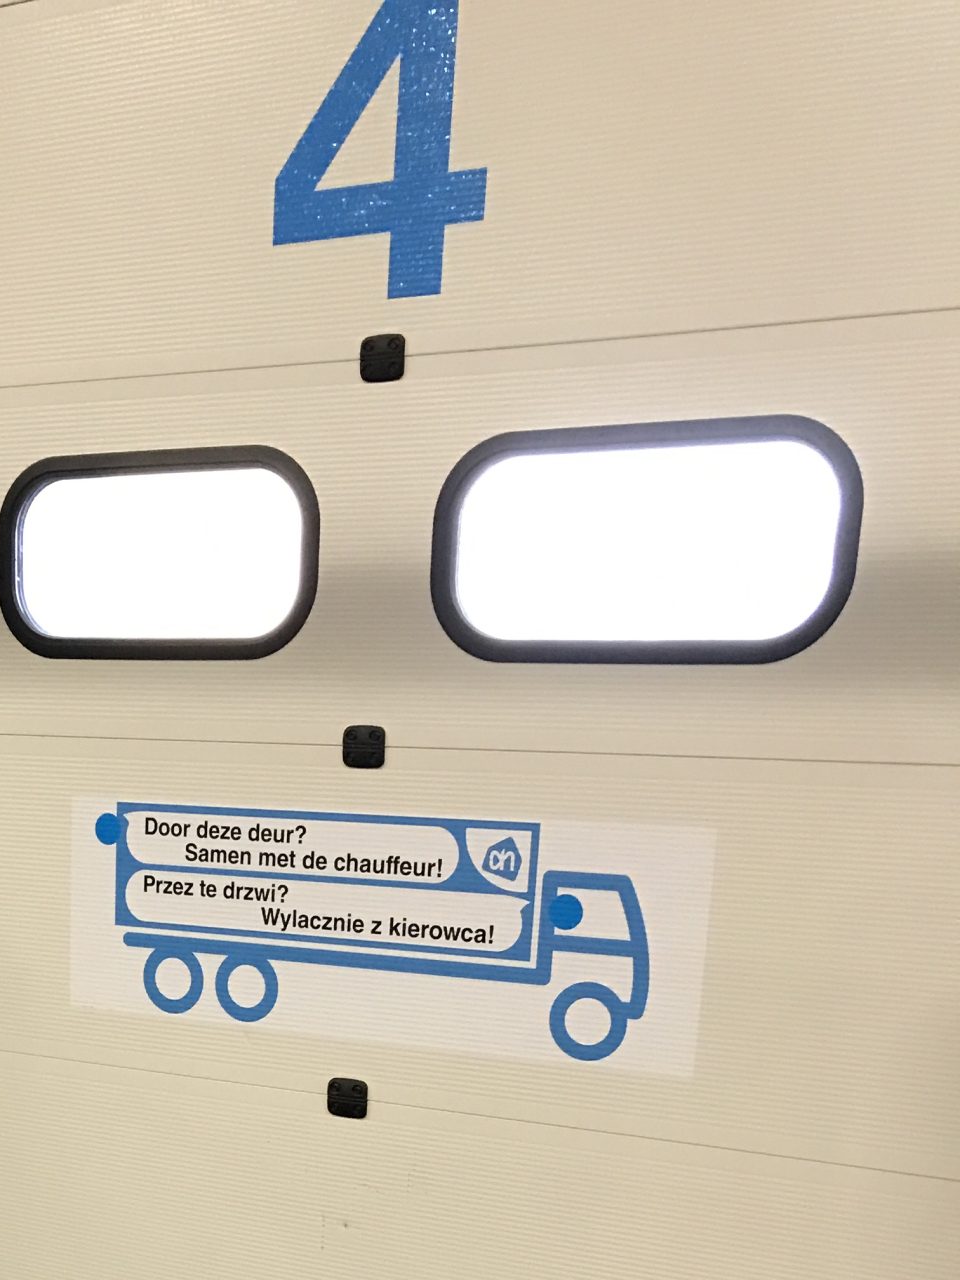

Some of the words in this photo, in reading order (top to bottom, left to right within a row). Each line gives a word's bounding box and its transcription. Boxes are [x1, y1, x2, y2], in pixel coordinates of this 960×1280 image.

[272, 0, 487, 299] 4
[144, 817, 191, 838] Door
[196, 820, 242, 841] deze
[248, 823, 307, 845] deur?
[185, 843, 251, 866] Samen
[258, 851, 296, 869] met
[302, 851, 328, 871] de
[333, 853, 443, 878] chauffeur!
[143, 875, 195, 897] Przez
[199, 880, 218, 899] te
[223, 881, 289, 903] drzwi?
[261, 906, 365, 933] Wylacznie
[370, 919, 382, 935] z
[389, 916, 495, 944] kierowca!
